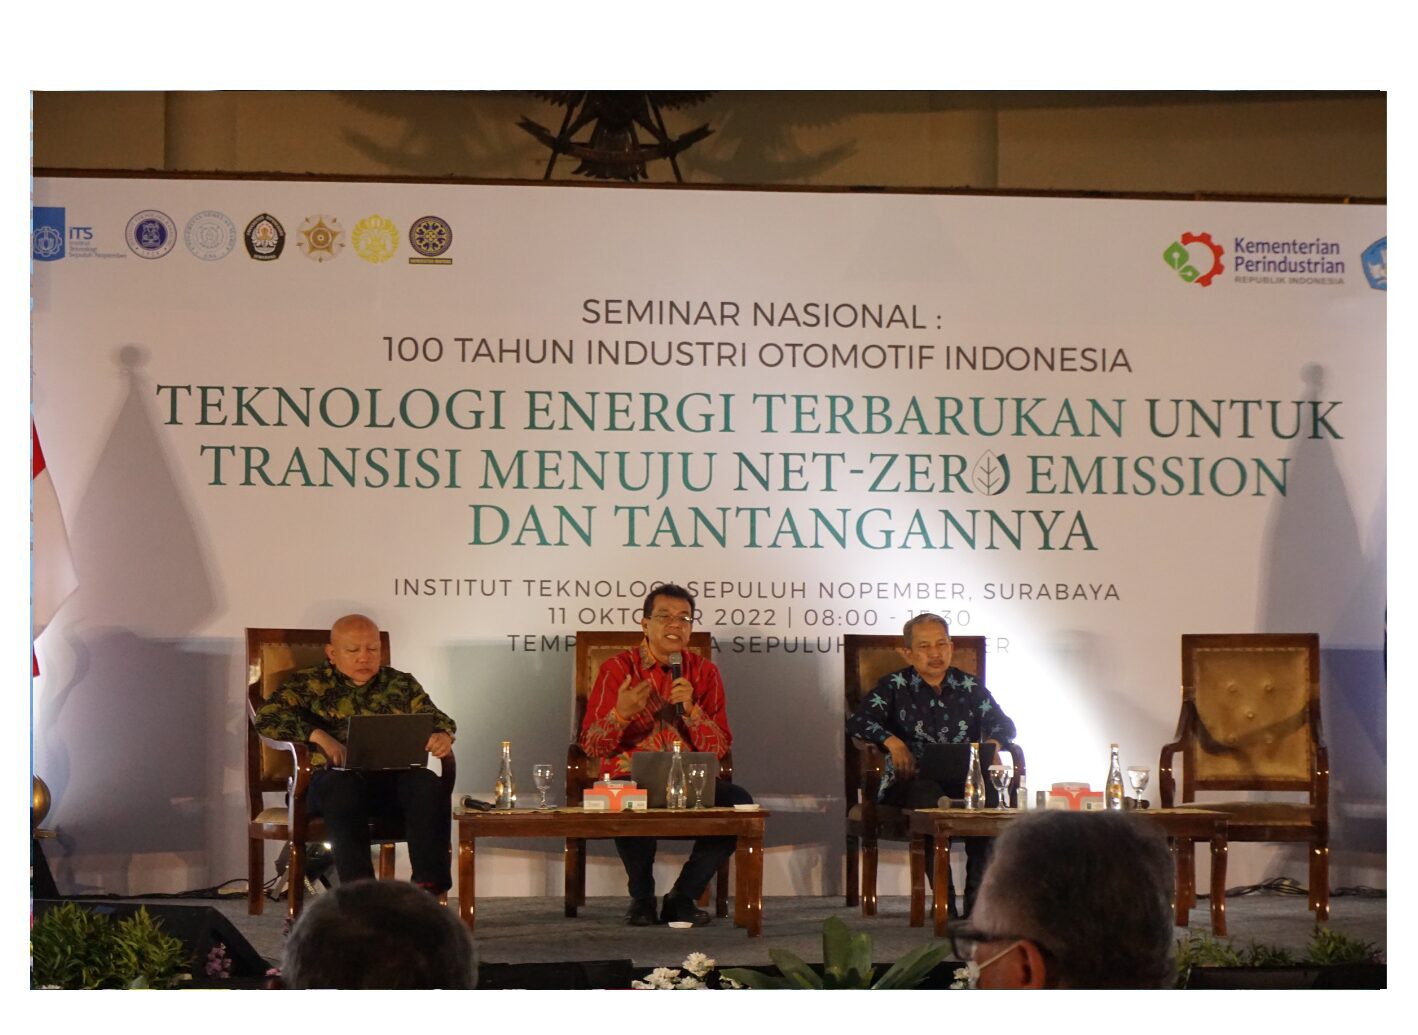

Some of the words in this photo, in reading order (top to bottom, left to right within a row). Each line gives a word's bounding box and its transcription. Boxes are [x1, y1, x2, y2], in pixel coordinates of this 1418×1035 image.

[1234, 237, 1340, 256] Kementerian
[1234, 256, 1345, 274] Perindustrian
[581, 298, 740, 327] SEMINAR
[753, 301, 928, 330] NASIONAL
[382, 336, 444, 363] 100
[453, 337, 575, 365] TAHUN
[587, 339, 747, 368] INDUSTRI
[758, 342, 936, 370] OTOMOTIF
[945, 345, 1133, 373] INDONESIA
[155, 383, 507, 431] TEKNOLOGI
[523, 389, 736, 433] ENERGI
[752, 392, 1127, 438] TERBARUKAN
[1144, 399, 1344, 440] UNTUK
[199, 444, 462, 490] TRANSISI
[478, 448, 718, 501] MENUJU
[1025, 453, 1292, 498] EMISSION
[467, 504, 598, 548] DAN
[613, 503, 1099, 552] TANTANGANNYA
[394, 577, 513, 597] INSTITUT
[523, 579, 675, 598] TEKNOLO
[686, 581, 807, 599] SEPULUH
[818, 581, 972, 602] NOPEMBER,
[983, 582, 1121, 601] SURABAYA
[547, 607, 567, 626] 11
[578, 607, 704, 626] OKTOR
[714, 608, 777, 627] 2022
[803, 608, 878, 627] 08:00
[507, 634, 578, 653] TEMP
